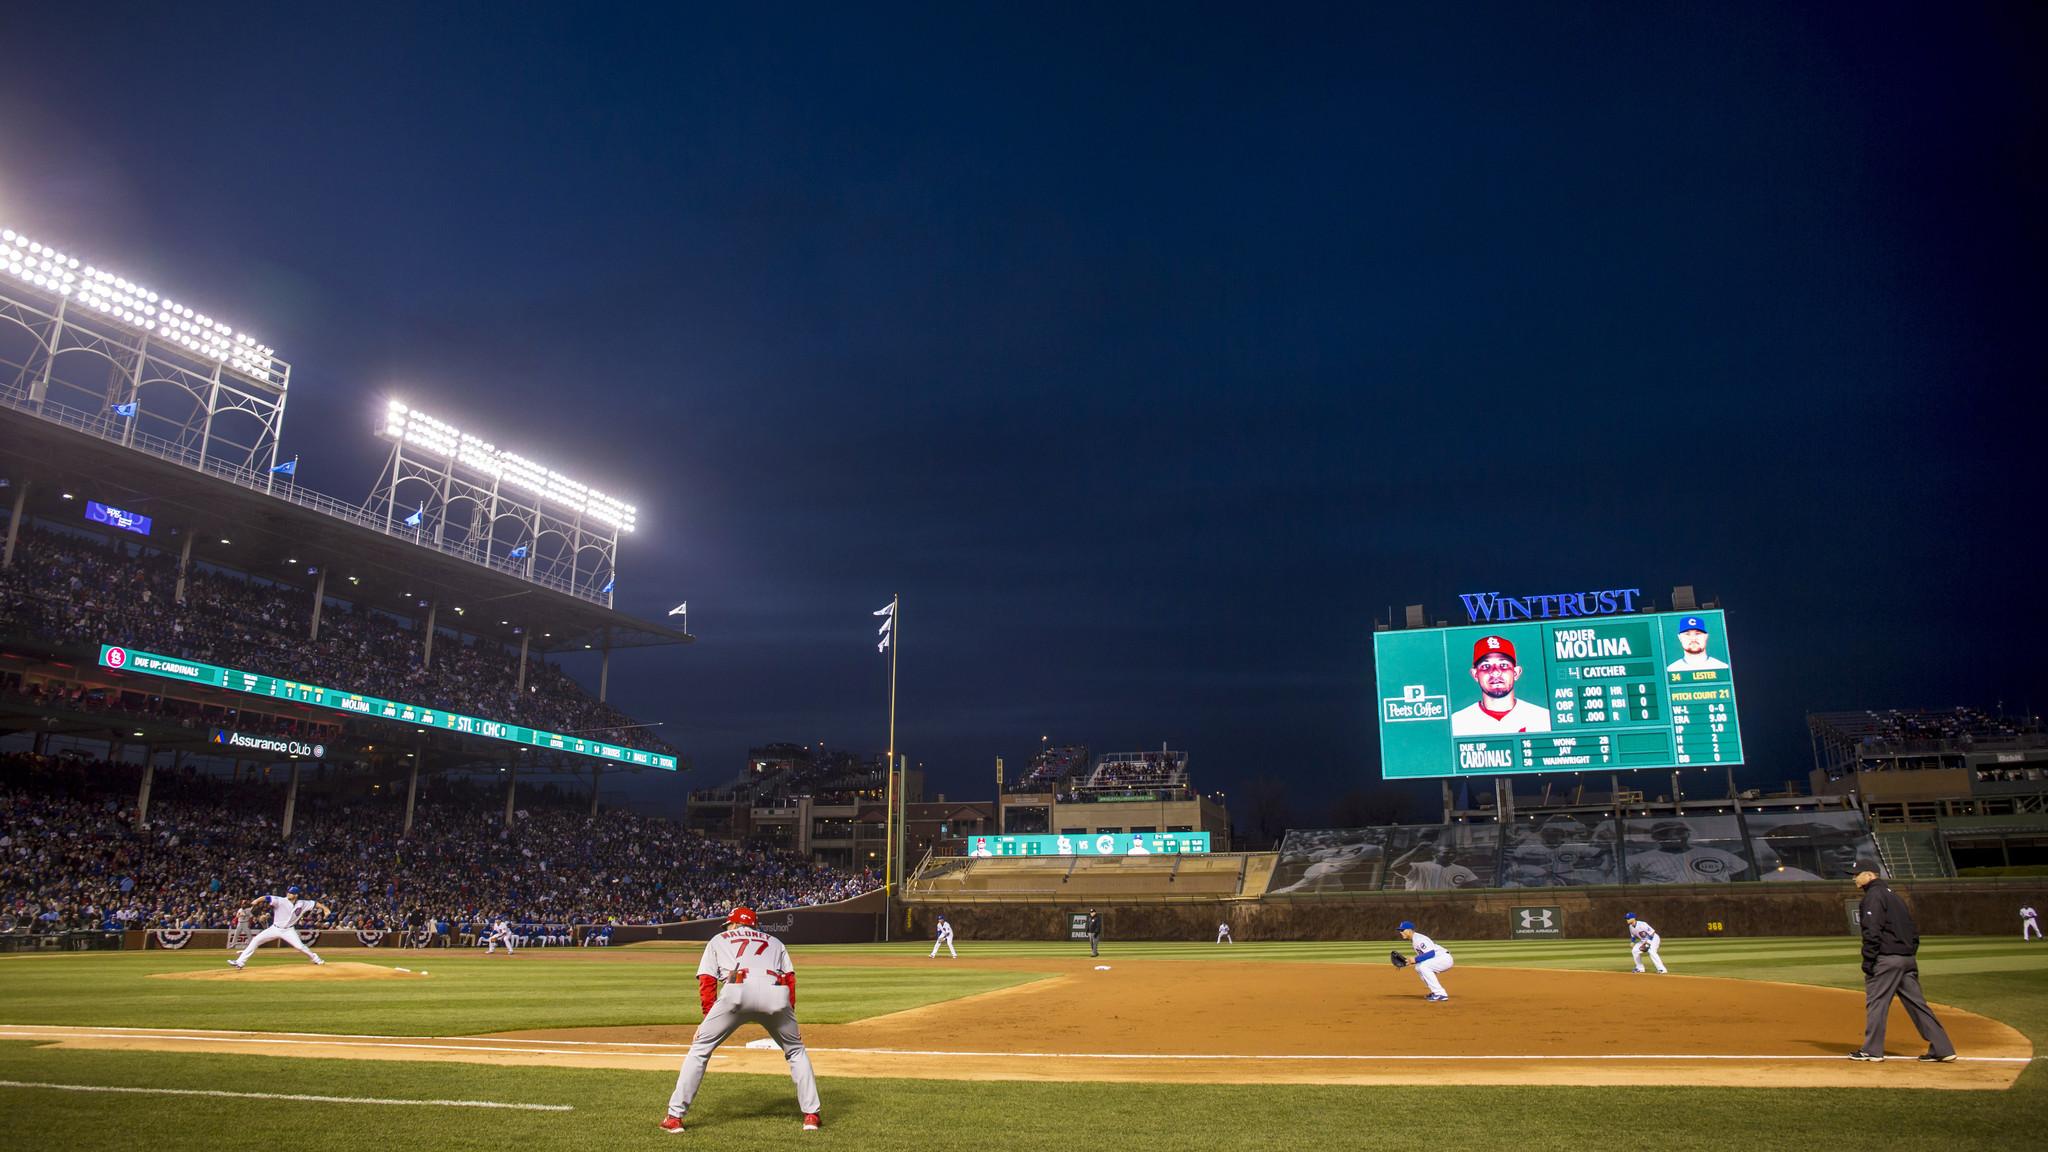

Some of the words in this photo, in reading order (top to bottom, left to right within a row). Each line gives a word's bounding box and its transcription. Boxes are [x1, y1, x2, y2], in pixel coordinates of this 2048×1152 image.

[1555, 629, 1596, 642] YADIER
[1555, 637, 1632, 659] MOLINA
[134, 656, 149, 667] DUE
[162, 661, 199, 677] CARDINALS
[1583, 665, 1626, 678] CATCHER
[1671, 673, 1681, 681] 34
[1692, 671, 1717, 680] LESTER
[1555, 688, 1574, 698] AVG
[1583, 686, 1602, 697] .000
[1609, 686, 1622, 695] HR
[1638, 684, 1646, 694] 0
[1672, 692, 1692, 701] PITCH
[1693, 691, 1717, 700] COUNT
[1718, 689, 1729, 699] 21
[341, 698, 370, 713] MOLINA
[1414, 702, 1442, 716] Coffee
[1556, 700, 1574, 711] OBP
[1584, 699, 1604, 709] .000
[1611, 699, 1626, 708] RBI
[1640, 697, 1647, 707] 0
[1672, 706, 1689, 714] W-L
[1708, 703, 1724, 713] 0-0
[1557, 713, 1574, 723] SLG
[1585, 711, 1605, 722] .000
[1612, 711, 1619, 721] R
[1641, 709, 1648, 719] 0
[1673, 715, 1690, 724] ERA
[1709, 713, 1727, 723] 9.00
[457, 716, 473, 733] STL
[483, 721, 500, 737] CHC
[1675, 725, 1684, 734] IP
[1711, 723, 1724, 732] 1.0
[229, 732, 288, 752] Assurance
[288, 741, 311, 756] Club
[1522, 740, 1531, 748] 16
[1553, 738, 1576, 746] WONG
[1676, 735, 1683, 744] H
[1711, 733, 1718, 742] 2
[1459, 743, 1474, 752] DUE
[1476, 743, 1487, 751] UP
[1558, 747, 1571, 756] JAY
[1677, 744, 1684, 754] K
[1712, 743, 1719, 752] 2
[1460, 749, 1512, 768] CARDINALS
[1543, 756, 1590, 765] WAINWRIGHT
[1603, 755, 1608, 763] P
[1678, 754, 1690, 763] BB
[1713, 753, 1720, 762] 0
[720, 931, 771, 940] MALONEY
[730, 938, 769, 959] 77
